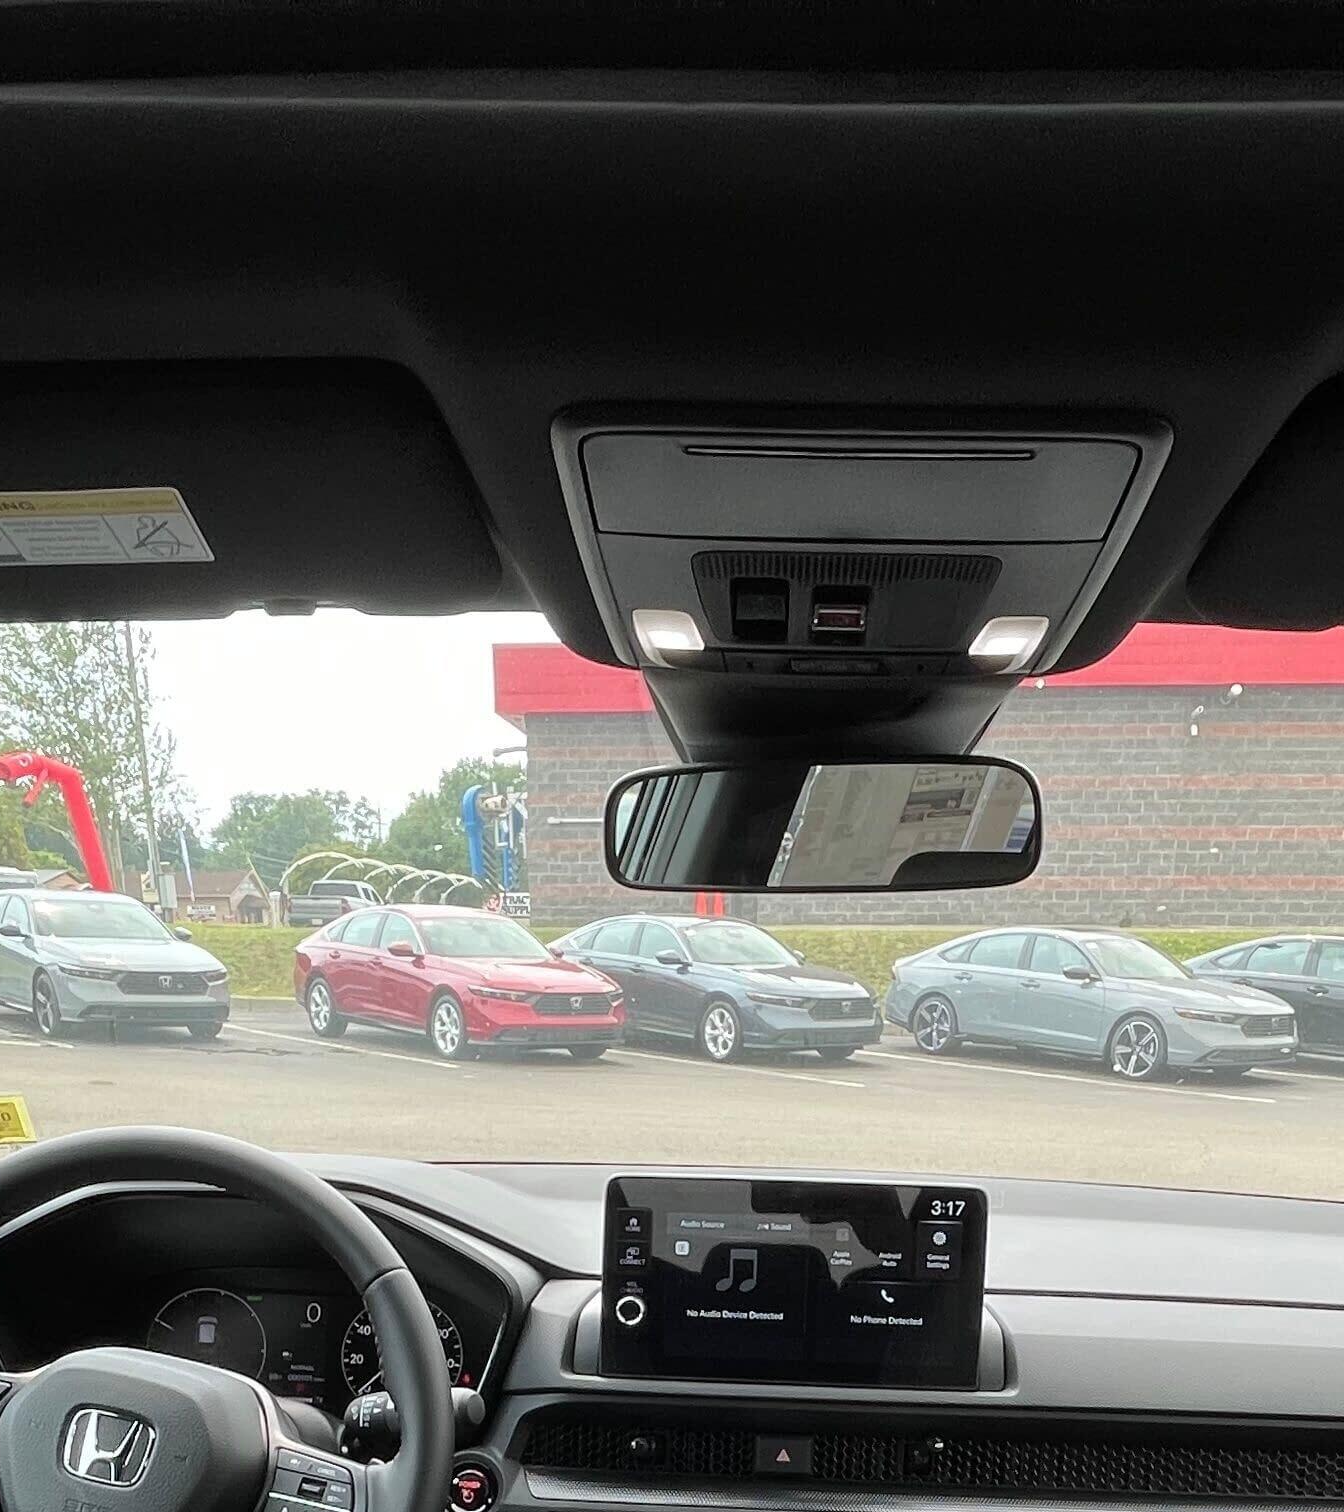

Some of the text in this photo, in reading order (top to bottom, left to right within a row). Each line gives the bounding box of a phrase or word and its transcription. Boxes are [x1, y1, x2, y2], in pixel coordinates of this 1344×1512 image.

[930, 1200, 966, 1216] 3:17
[680, 1219, 701, 1228] Audio
[306, 1302, 322, 1323] 0
[686, 1309, 784, 1321] No Audio Device Detected
[850, 1315, 923, 1326] No Phone Detected
[356, 1324, 372, 1336] 40
[349, 1353, 364, 1365] 20
